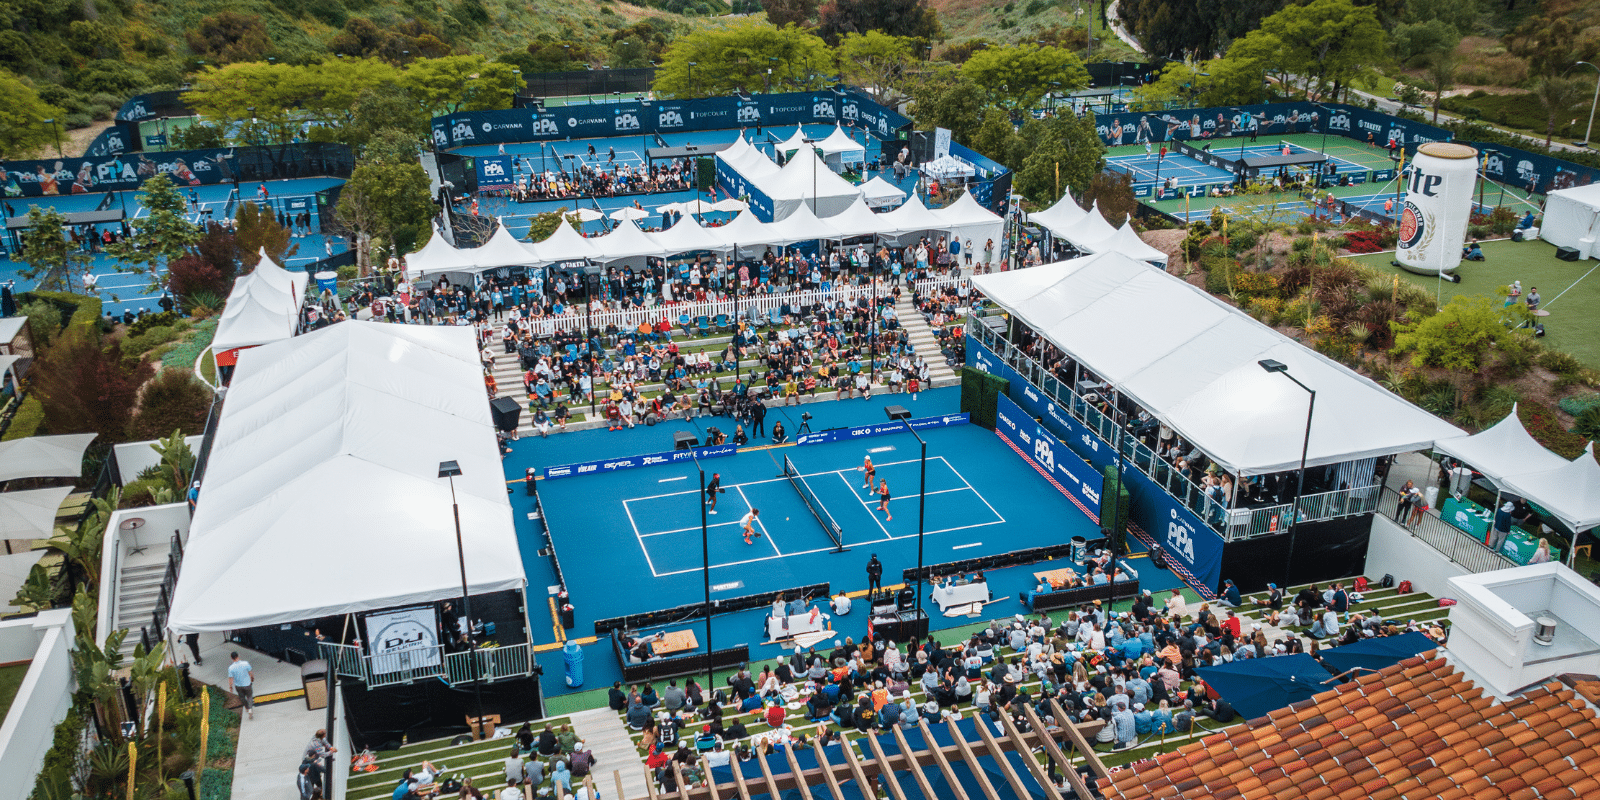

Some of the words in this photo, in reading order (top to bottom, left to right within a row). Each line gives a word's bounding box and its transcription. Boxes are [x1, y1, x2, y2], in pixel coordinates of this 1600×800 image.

[737, 106, 761, 119] PPA
[813, 102, 835, 115] PPA
[615, 114, 640, 127] PPA
[659, 111, 684, 124] PPA
[1203, 119, 1216, 127] PPA
[1274, 114, 1286, 122] PPA
[1299, 113, 1311, 122] PPA
[1329, 114, 1350, 129] PPA
[452, 123, 474, 140] PPA
[533, 119, 559, 132] PPA
[1123, 123, 1136, 132] PPA
[97, 160, 138, 180] PPA
[484, 164, 505, 174] PPA
[1407, 165, 1442, 197] ite
[1035, 439, 1055, 470] PPA
[1167, 521, 1195, 561] PPA
